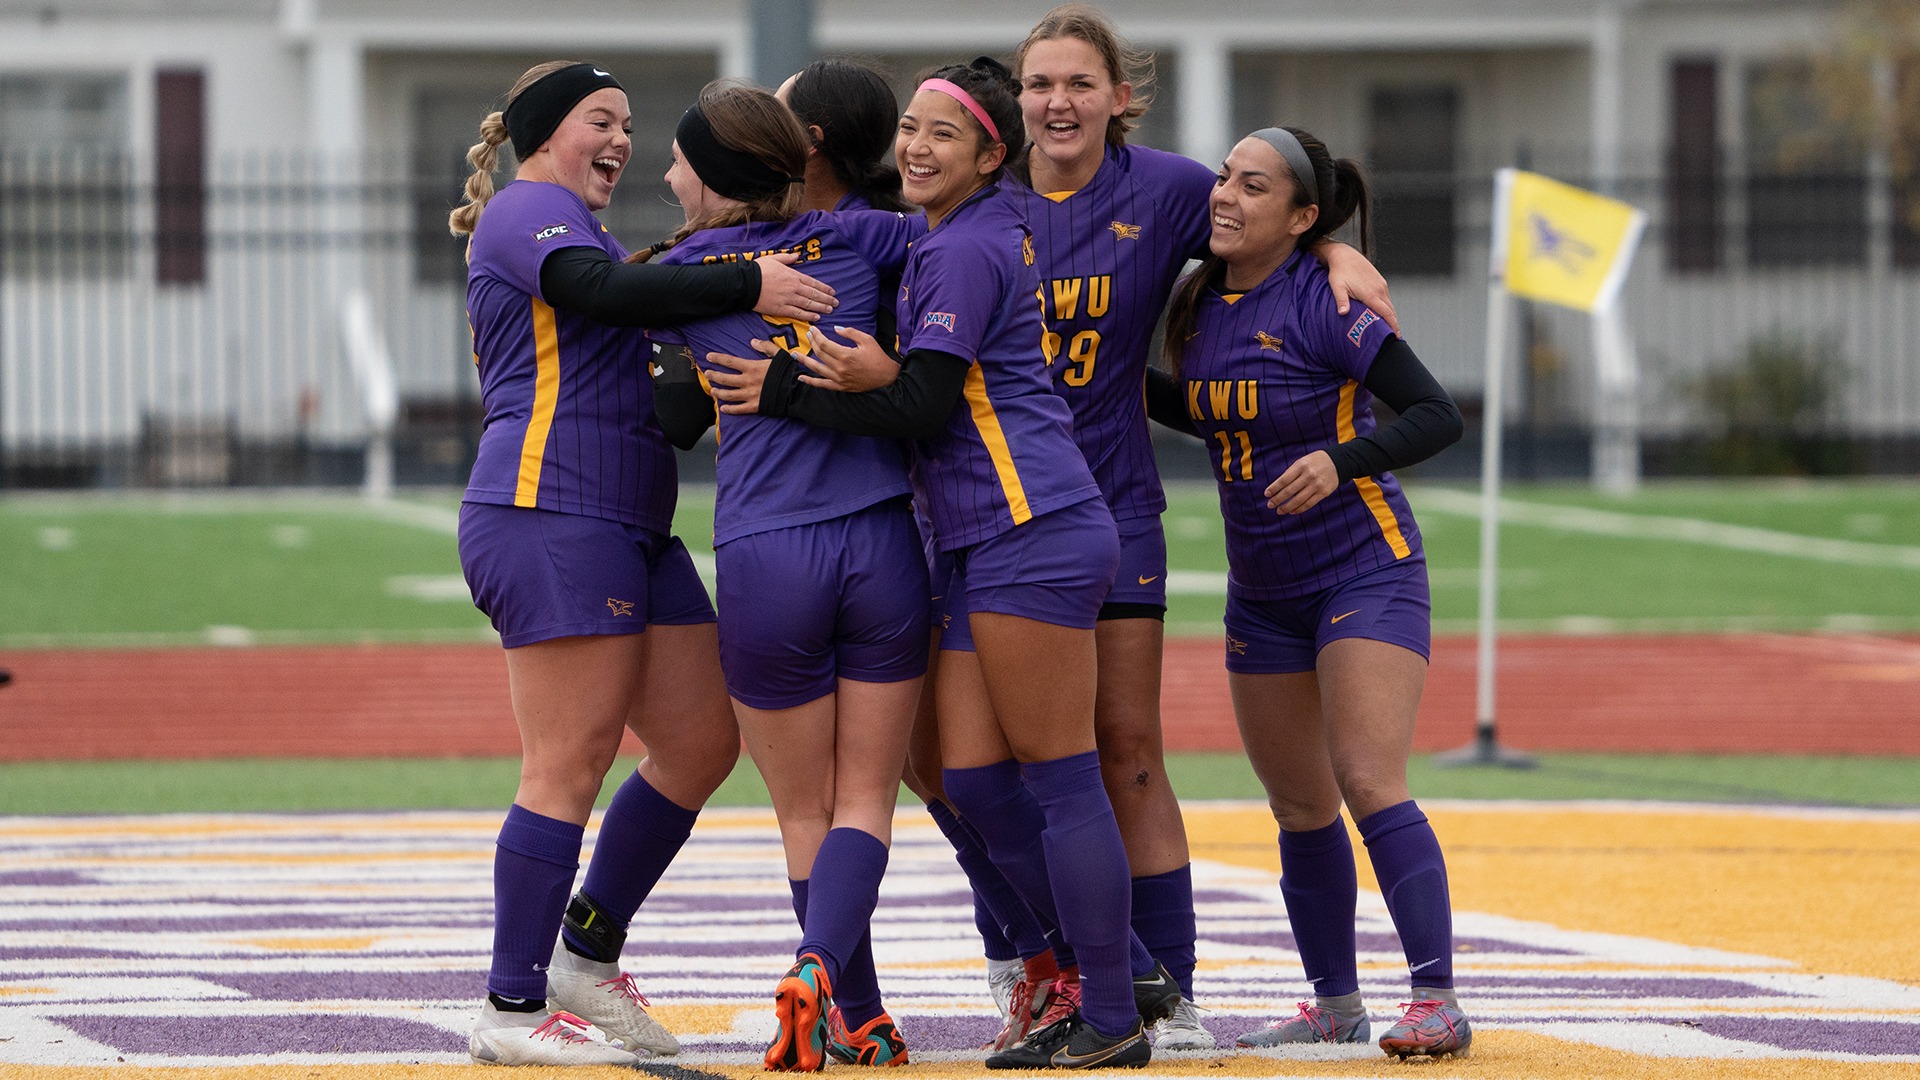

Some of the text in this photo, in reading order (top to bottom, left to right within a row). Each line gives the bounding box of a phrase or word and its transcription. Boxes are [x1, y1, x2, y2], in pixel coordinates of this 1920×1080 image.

[1050, 274, 1112, 321] WU
[925, 313, 952, 329] NAIA
[1349, 311, 1375, 343] NAIA
[1187, 379, 1259, 421] KWU
[1214, 430, 1254, 482] 11
